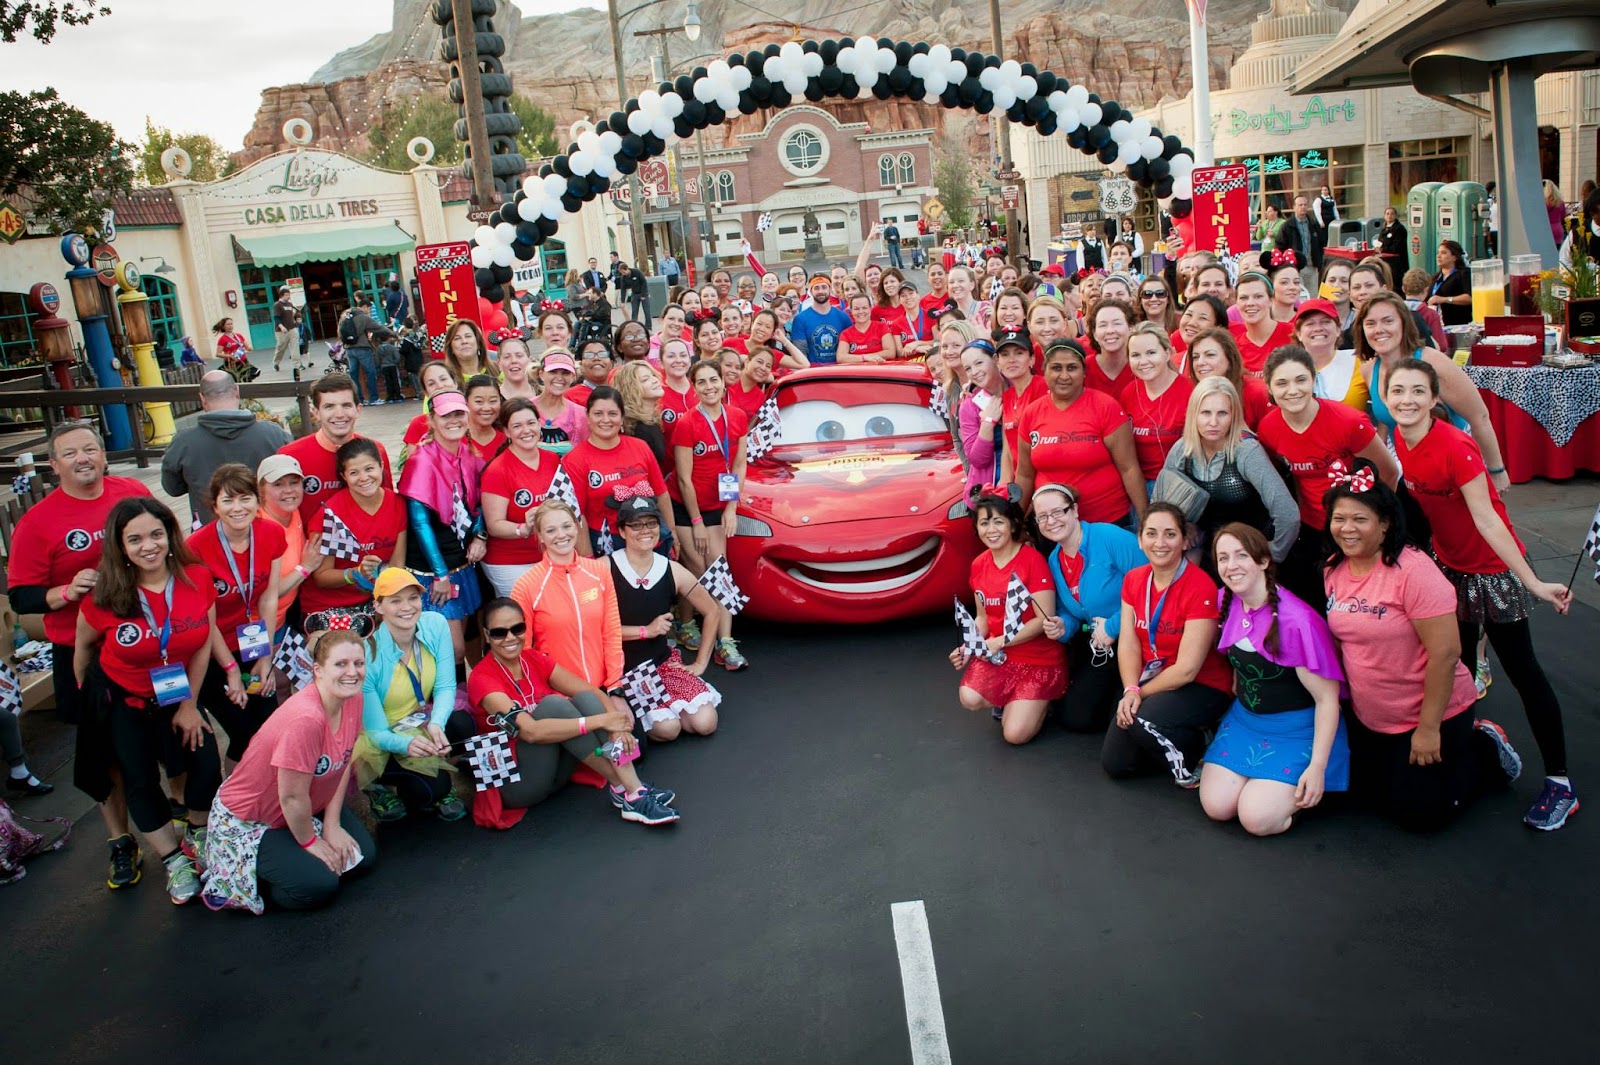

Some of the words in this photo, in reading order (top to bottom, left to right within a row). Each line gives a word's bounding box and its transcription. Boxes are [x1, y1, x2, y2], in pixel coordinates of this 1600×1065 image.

[1227, 104, 1291, 135] Body
[1300, 95, 1357, 127] Art
[608, 186, 651, 200] TIRS
[1105, 186, 1133, 210] 66
[4, 211, 22, 232] AS
[245, 207, 287, 225] CASA
[289, 203, 336, 220] DELLA
[338, 199, 379, 217] TIRES
[1066, 212, 1086, 223] DROP
[1006, 332, 1017, 340] D
